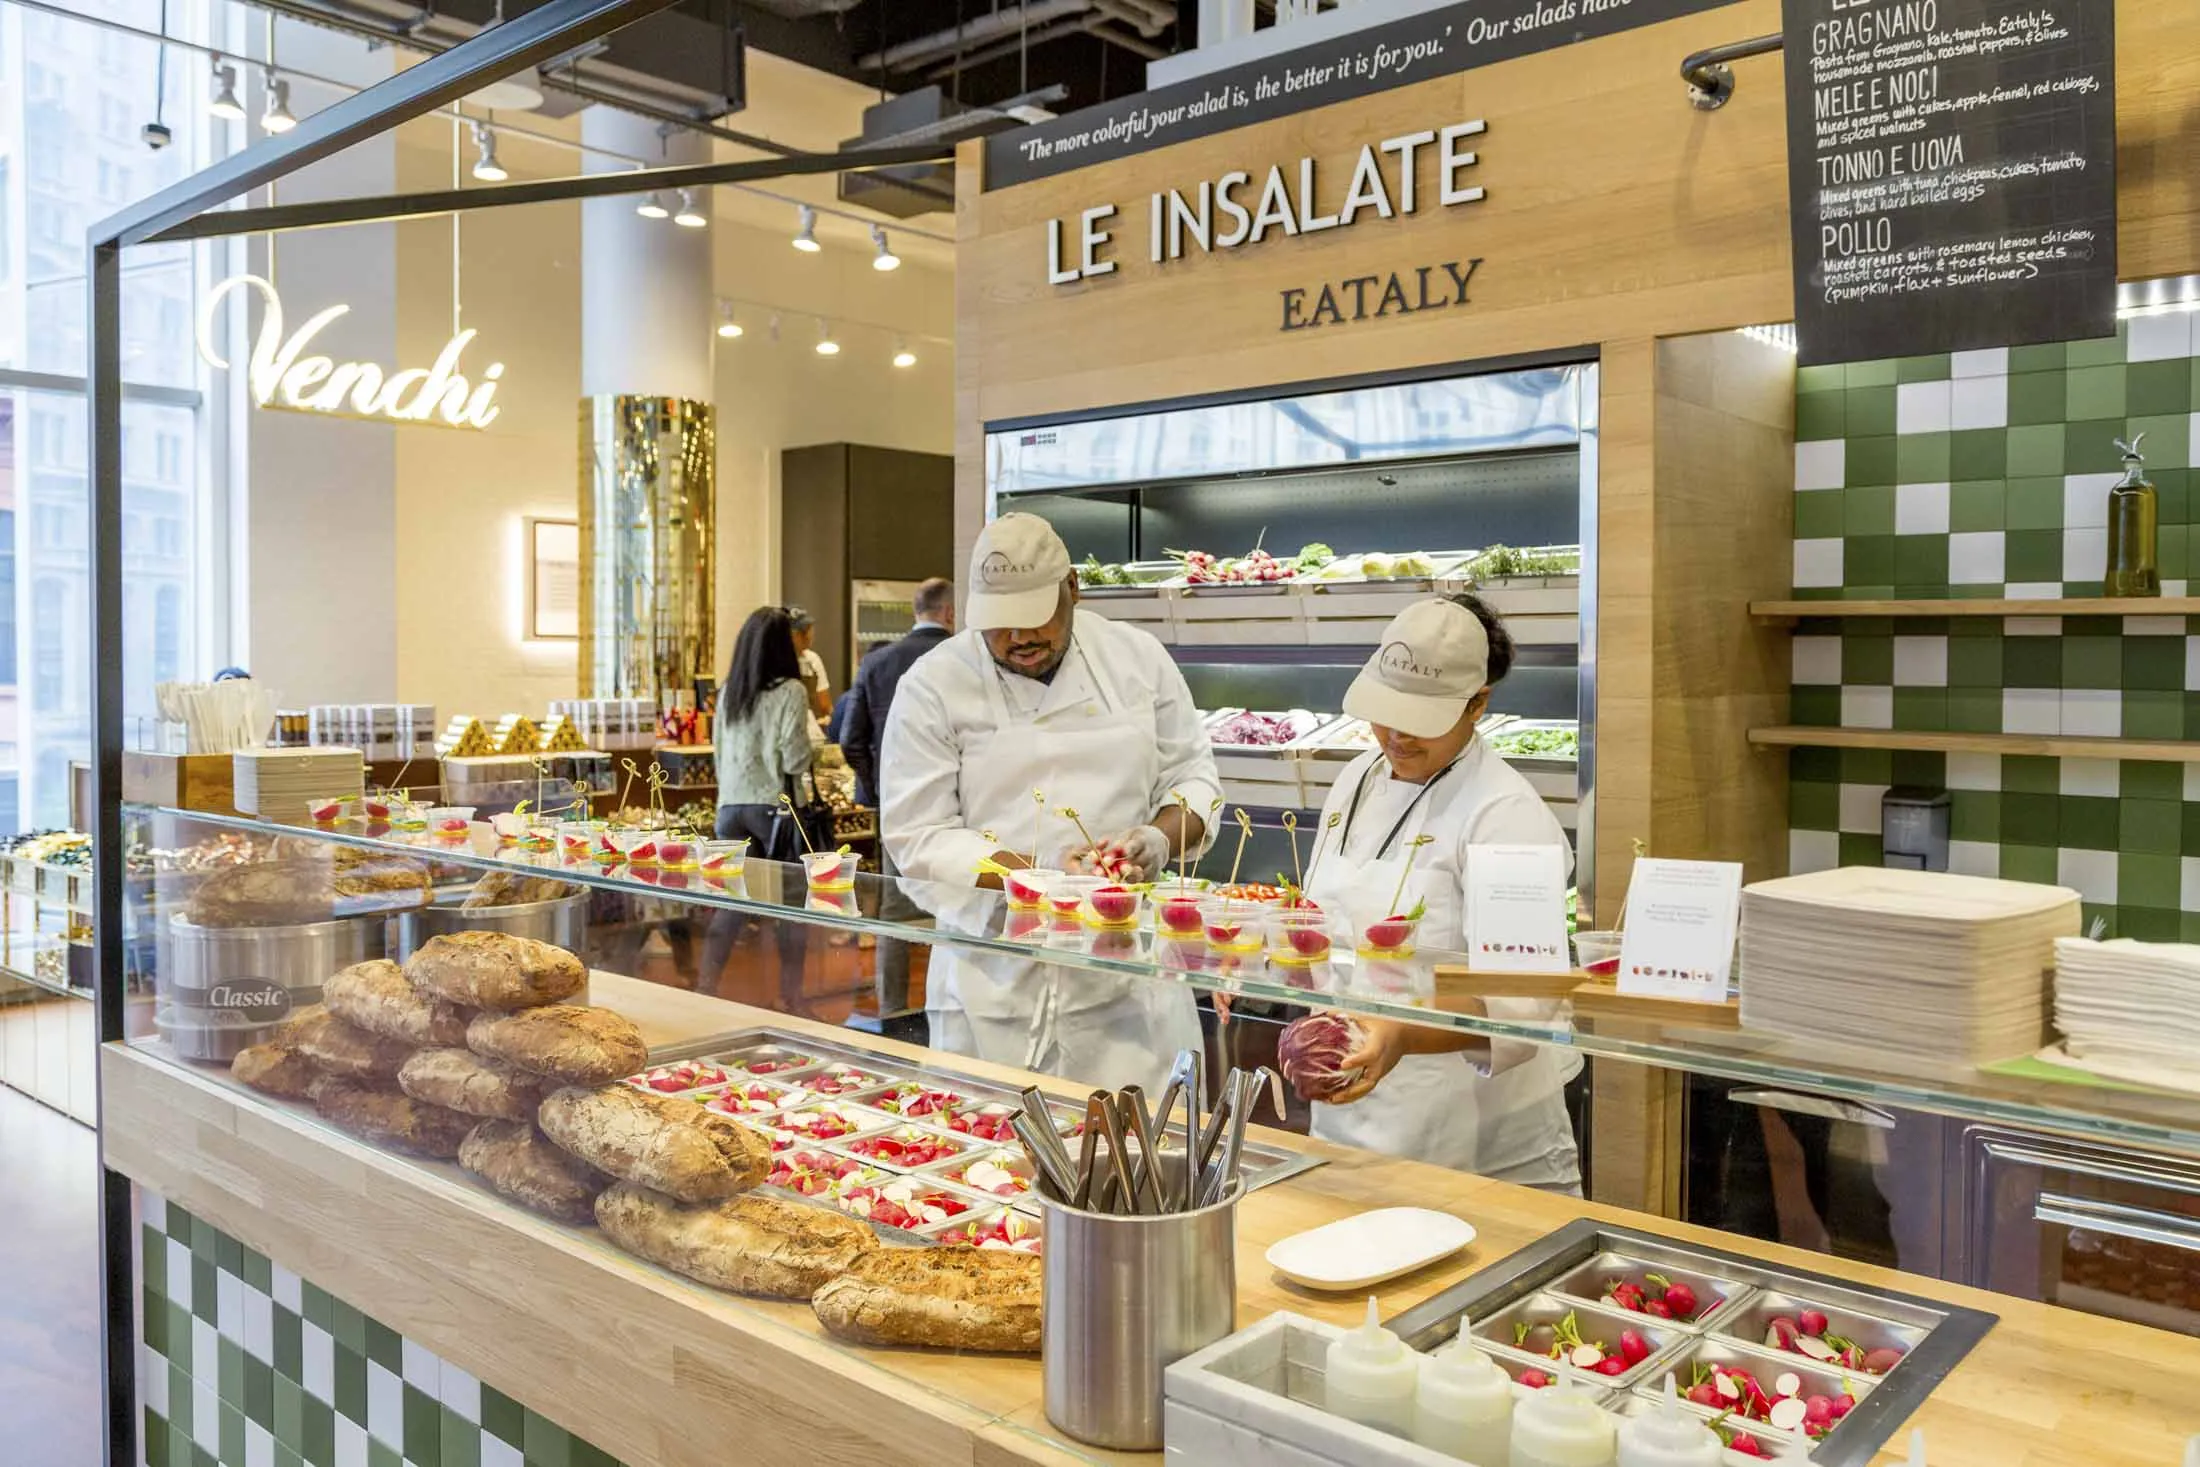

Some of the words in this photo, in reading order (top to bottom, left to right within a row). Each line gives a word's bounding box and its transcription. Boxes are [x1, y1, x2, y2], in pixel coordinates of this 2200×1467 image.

[1813, 0, 1937, 55] GRAGNANO
[1845, 48, 1871, 65] from
[1952, 22, 1998, 41] tomato,
[1938, 39, 1978, 59] roasted
[1020, 138, 1052, 161] “The
[1055, 132, 1090, 153] more
[1092, 108, 1148, 144] colorful
[1144, 106, 1186, 138] your
[1187, 86, 1230, 119] salad
[1233, 86, 1249, 107] is,
[1255, 75, 1281, 101] the
[1284, 66, 1335, 93] better
[1338, 57, 1352, 79] it
[1355, 52, 1369, 75] is
[1368, 43, 1401, 80] for
[1467, 17, 1510, 45] Our
[1512, 0, 1577, 34] salads
[1815, 81, 1865, 120] MELE
[1871, 78, 1883, 110] E
[1889, 65, 1938, 106] NOCI
[1816, 117, 1849, 136] Mixed
[1851, 111, 1890, 133] greens
[1893, 104, 1916, 119] with
[2033, 80, 2050, 95] red
[1817, 134, 1838, 149] and
[1840, 124, 1876, 145] spiced
[1879, 118, 1927, 136] walnuts
[1817, 149, 1884, 186] TONNO
[1891, 145, 1905, 176] E
[1911, 134, 1964, 172] UOVA
[1820, 188, 1851, 206] Mixed
[1852, 183, 1887, 205] greens
[1889, 176, 1912, 193] with
[2039, 152, 2086, 173] tomato,
[1048, 203, 1115, 285] LE
[1151, 119, 1487, 262] INSALATE
[1855, 201, 1876, 215] and
[1880, 192, 1907, 210] hard
[1911, 187, 1949, 206] boiled
[1952, 183, 1986, 203] eggs
[1822, 217, 1891, 258] POLLO
[1824, 256, 1856, 273] Mixed
[1859, 252, 1902, 271] greens
[1908, 244, 1935, 261] with
[1938, 240, 1996, 257] rosemary
[2000, 236, 2037, 250] lemon
[1824, 271, 1870, 288] roasted
[1873, 263, 1933, 280] carrots,
[1936, 259, 1945, 272] &
[1949, 252, 2011, 270] toasted
[2016, 247, 2067, 263] seeds
[1894, 275, 1930, 293] flax
[1931, 276, 1942, 287] +
[1279, 257, 1485, 332] EATALY
[195, 274, 505, 428] Venchi
[210, 985, 283, 1008] Classic
